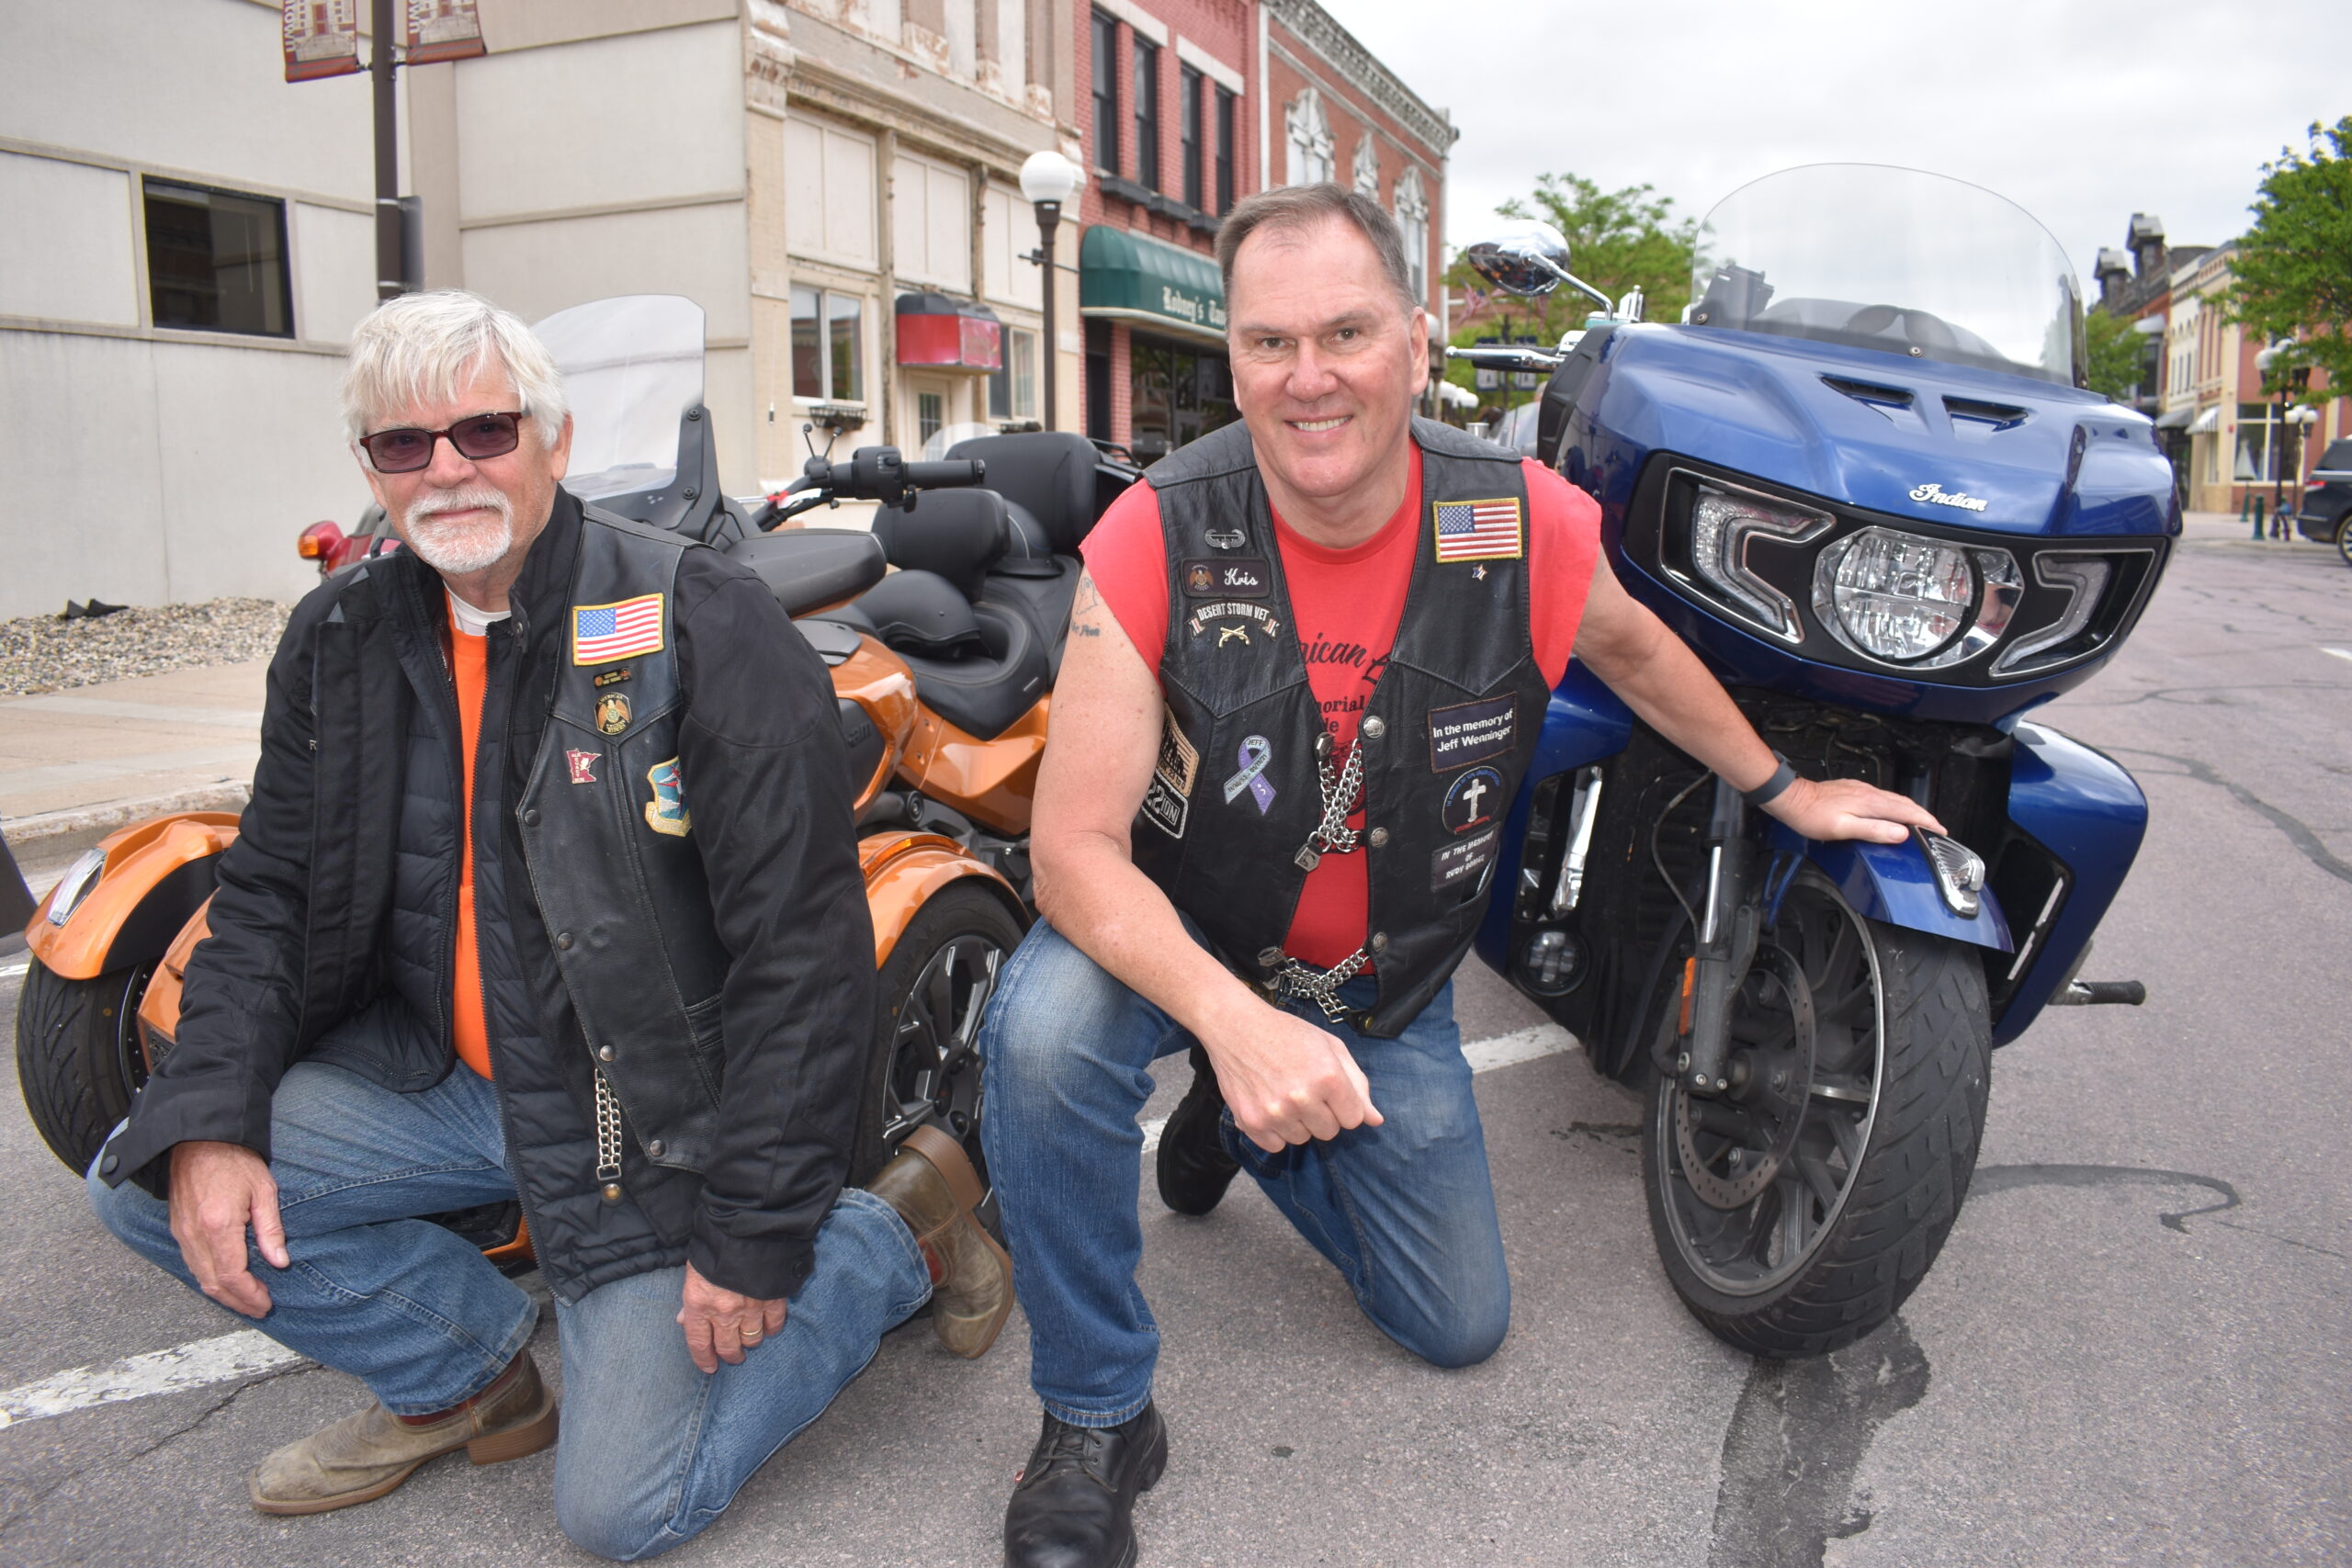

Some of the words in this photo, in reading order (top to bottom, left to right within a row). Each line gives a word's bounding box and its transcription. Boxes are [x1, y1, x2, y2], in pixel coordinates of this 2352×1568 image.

[1162, 286, 1204, 323] Rodney's
[1909, 483, 1988, 512] Indian
[1224, 568, 1258, 585] Kris
[1196, 603, 1227, 622] DESERT
[1227, 603, 1253, 617] STORM
[1254, 606, 1270, 622] VET
[1432, 727, 1443, 738] In
[1444, 724, 1462, 736] the
[1463, 715, 1503, 732] memory
[1504, 707, 1514, 721] of
[1437, 738, 1459, 752] Jeff
[1461, 725, 1512, 747] Wenninger
[1441, 851, 1451, 862] IN
[1453, 844, 1467, 855] THE
[1466, 830, 1494, 851] MEMORY
[1445, 865, 1464, 879] RUDY
